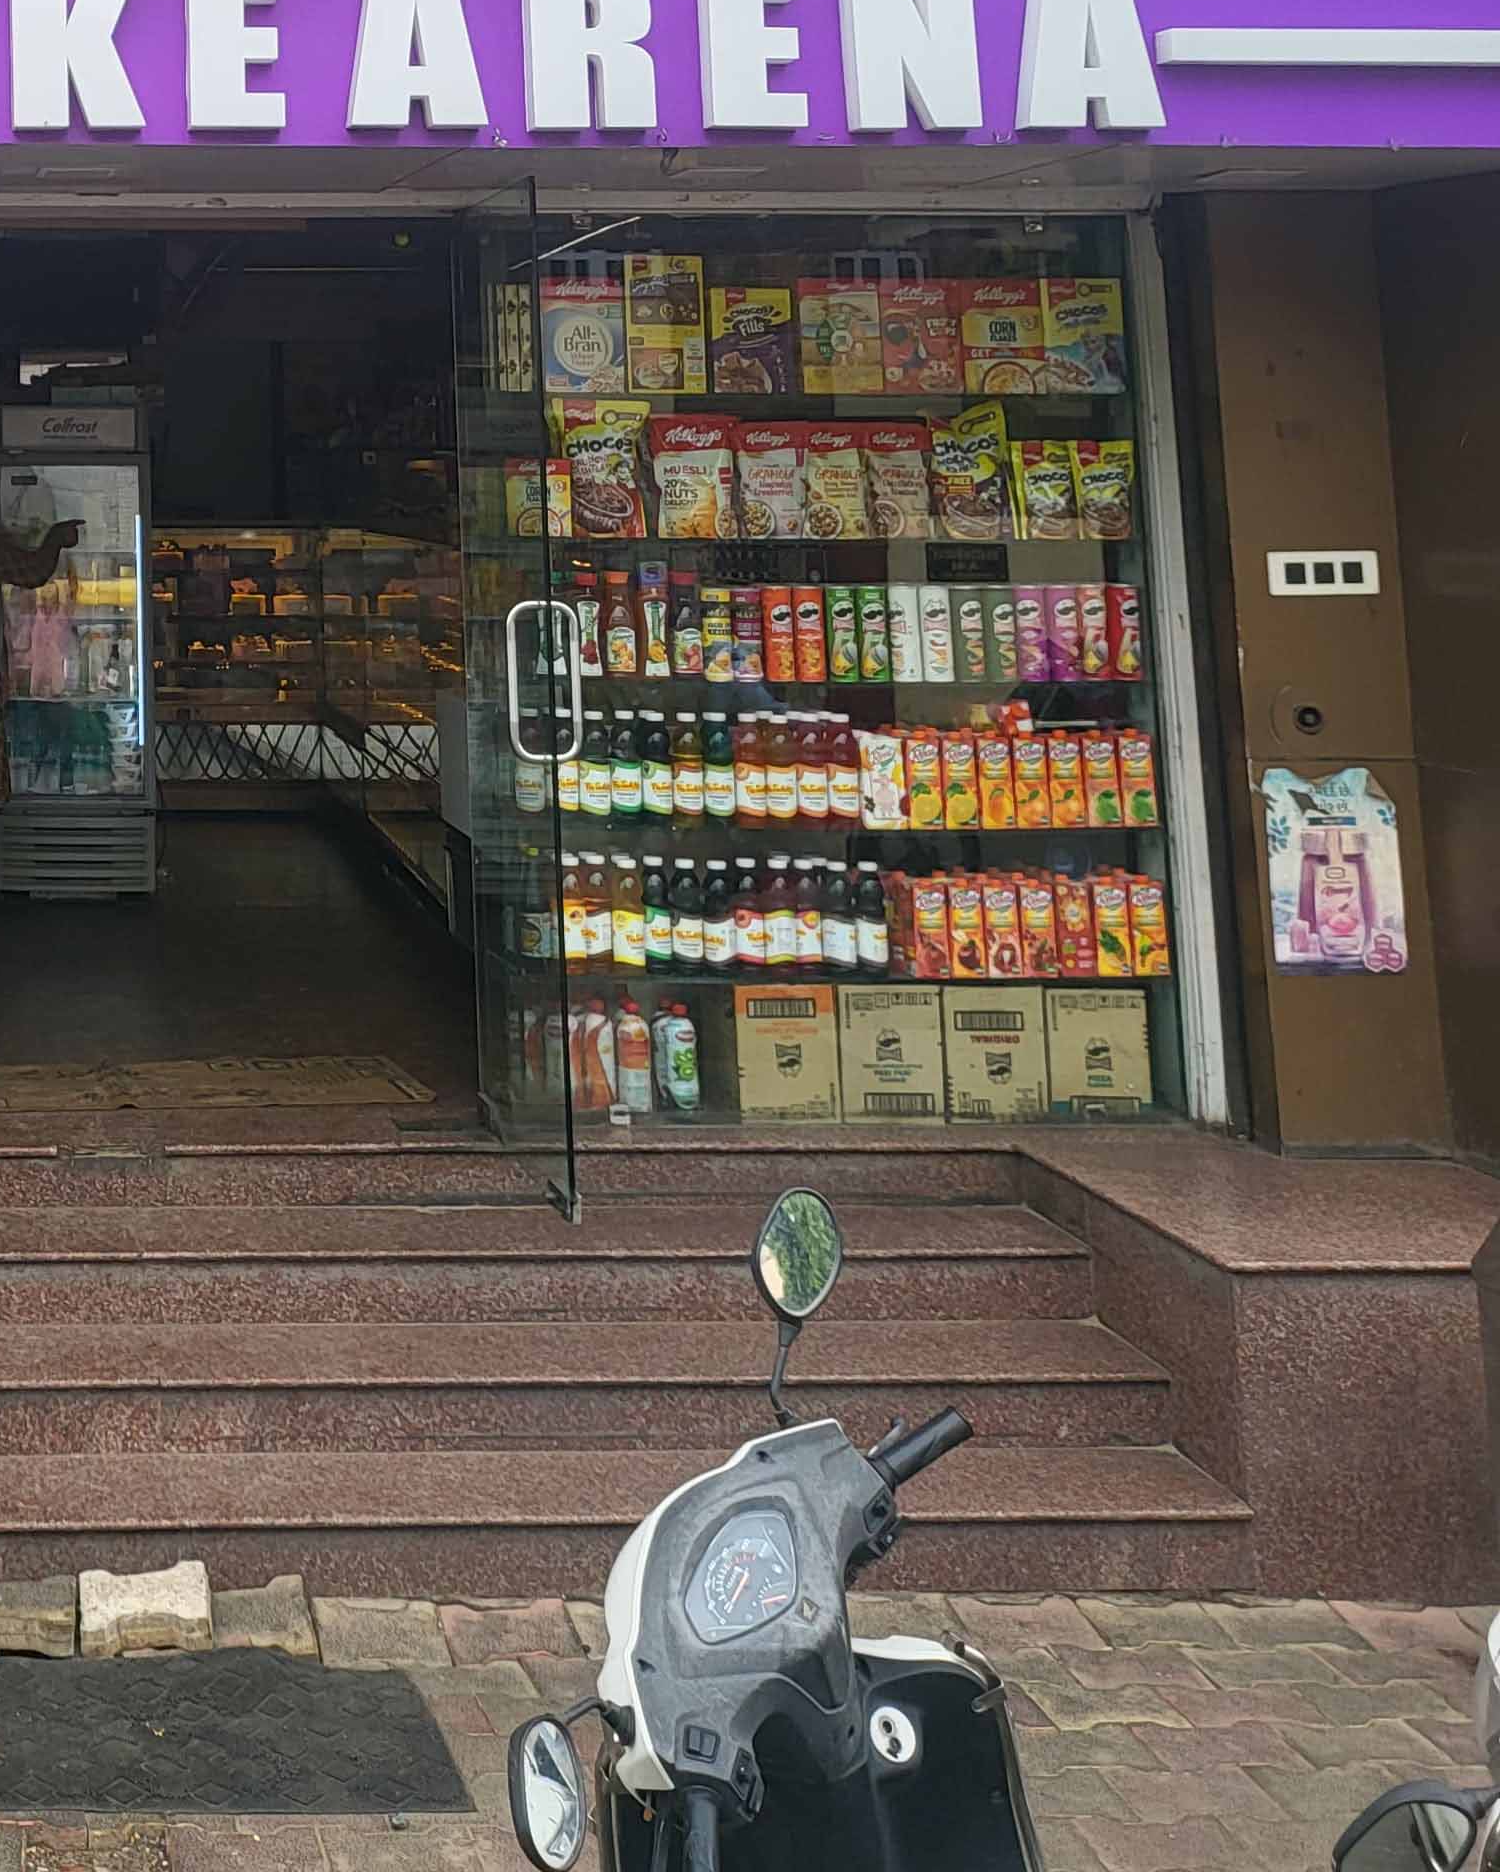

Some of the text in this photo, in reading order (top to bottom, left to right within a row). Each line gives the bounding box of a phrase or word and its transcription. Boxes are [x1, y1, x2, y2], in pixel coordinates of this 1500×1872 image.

[571, 325, 597, 340] All-
[739, 320, 765, 336] Fills
[563, 336, 602, 352] Bran
[663, 465, 707, 476] MUESLI
[664, 488, 699, 499] NUTS
